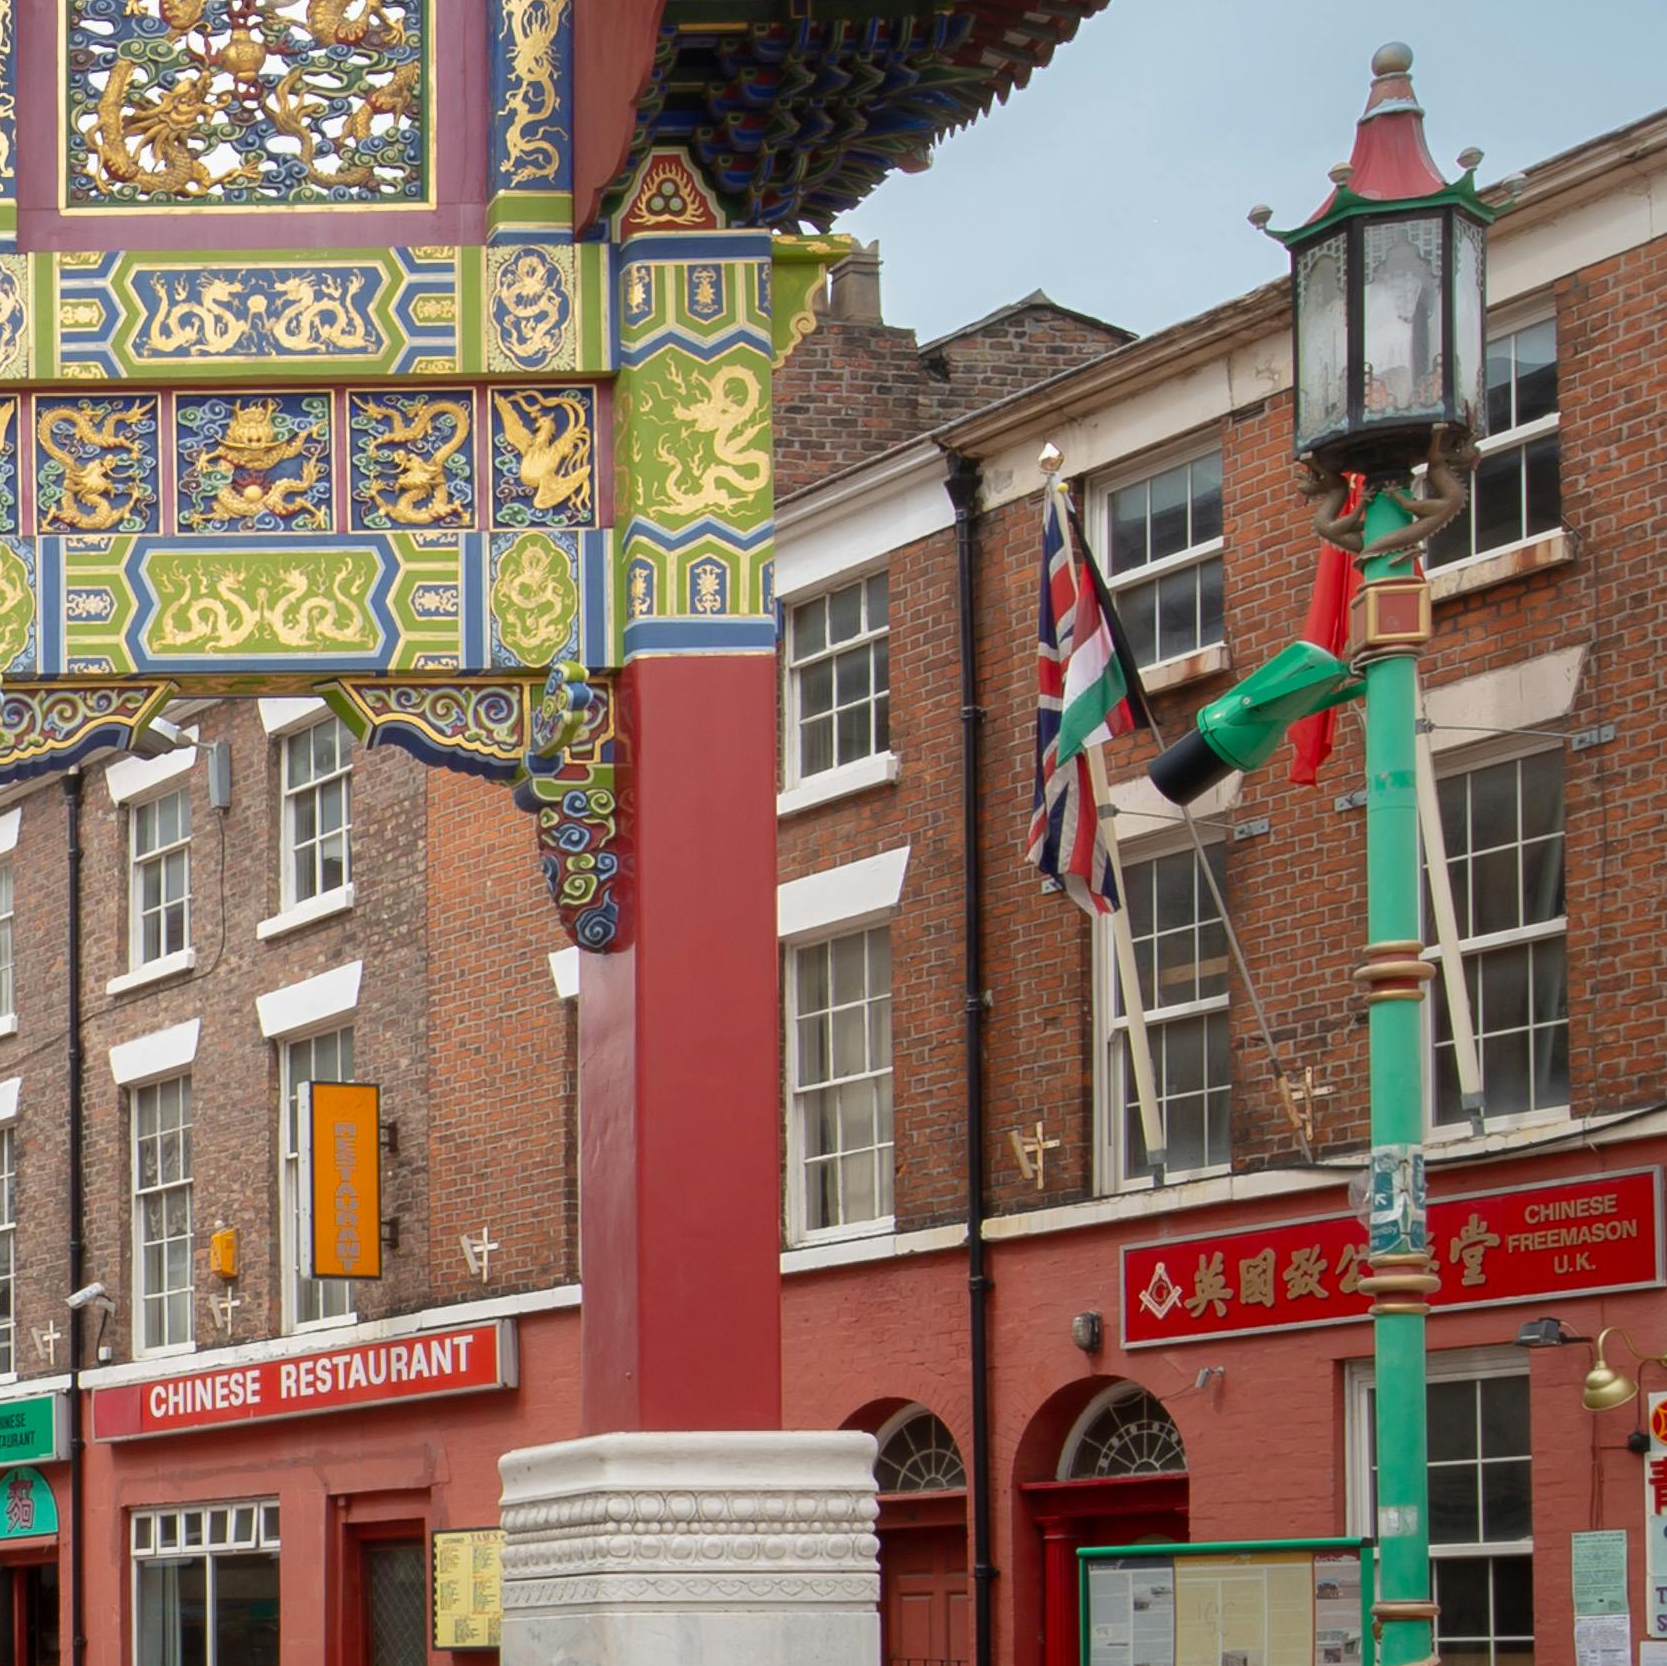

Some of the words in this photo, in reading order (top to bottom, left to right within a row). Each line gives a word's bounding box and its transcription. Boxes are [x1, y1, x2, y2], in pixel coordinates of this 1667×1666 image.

[334, 1122, 361, 1273] RESTAURANT
[1524, 1194, 1618, 1224] CHINESE
[1184, 1213, 1501, 1318] 英國致公堂
[1508, 1219, 1638, 1253] FREEMASON
[1554, 1252, 1596, 1274] U.K.
[149, 1369, 261, 1418] CHINESE
[280, 1334, 473, 1399] RESTAURANT
